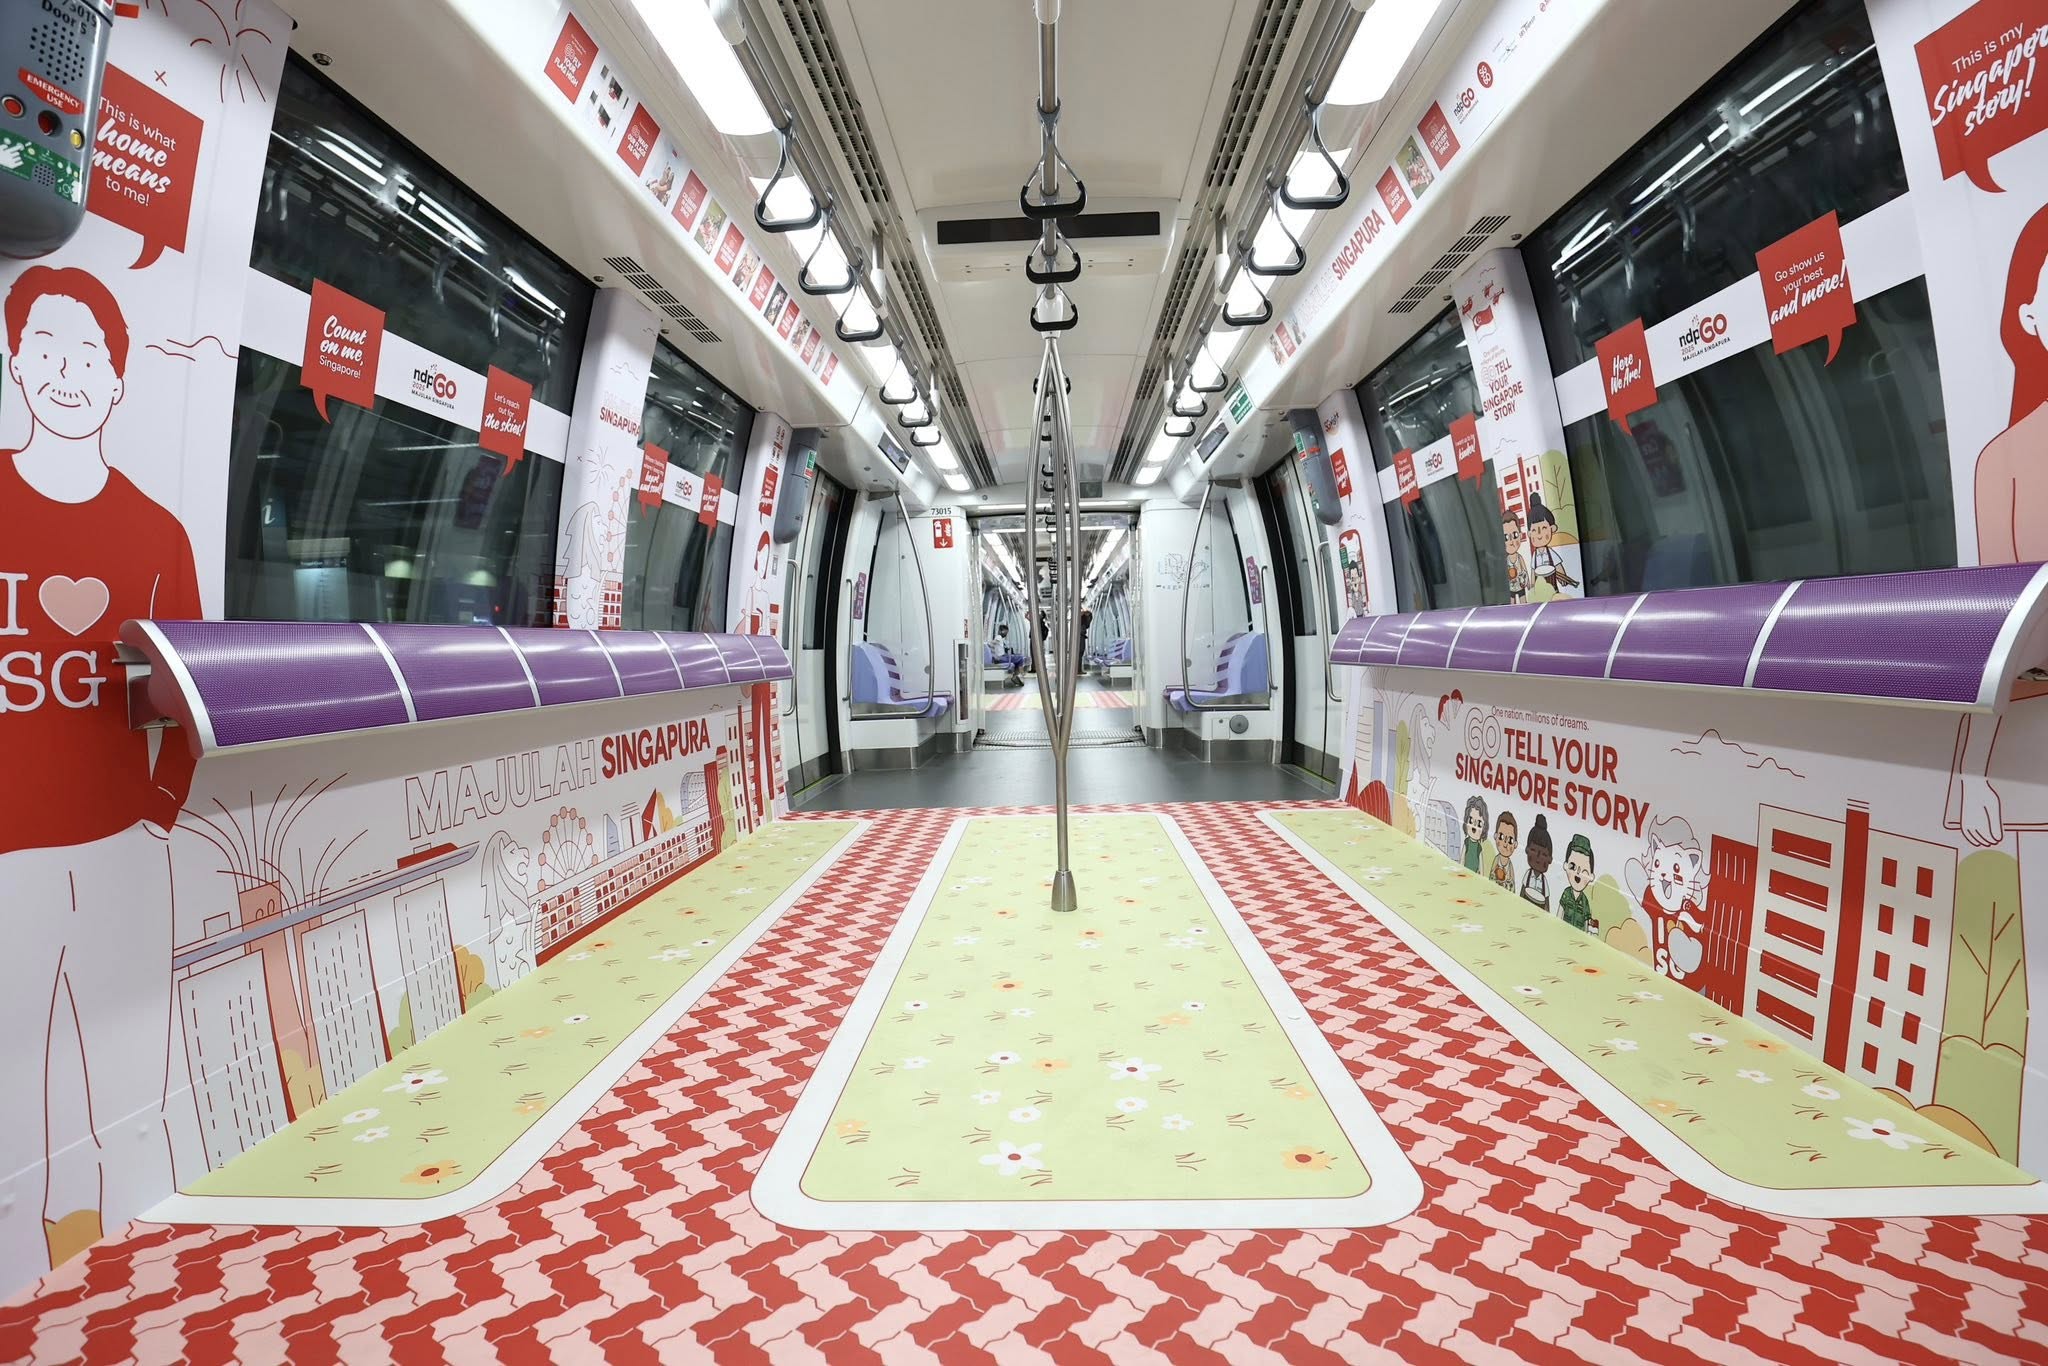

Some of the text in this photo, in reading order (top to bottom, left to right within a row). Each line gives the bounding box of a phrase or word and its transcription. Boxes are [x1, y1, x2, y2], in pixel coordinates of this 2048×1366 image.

[42, 0, 77, 27] Door
[1952, 22, 2023, 73] This is my
[554, 57, 579, 88] FLAG HIGH
[564, 57, 577, 74] YOUR
[1932, 24, 2048, 127] Singapor
[27, 74, 81, 108] EMERGENCY
[46, 93, 64, 109] USE
[1964, 57, 2036, 136] story!
[98, 97, 176, 151] This is what
[1429, 124, 1447, 148] CELEBRATE
[97, 118, 168, 168] home
[1438, 132, 1449, 147] EVERY
[92, 146, 172, 194] means
[105, 176, 120, 193] to
[123, 183, 150, 207] me!
[1332, 208, 1385, 281] SINGAPURA
[1774, 251, 1825, 282] Go show us
[1783, 266, 1824, 295] your best
[1770, 259, 1846, 325] and more!
[323, 315, 368, 345] Count
[319, 339, 364, 366] on me,
[1612, 352, 1633, 372] Here
[1681, 344, 1695, 355] 2025
[1682, 336, 1731, 362] MAJULAH SINGAPURA
[319, 355, 361, 379] Singapore!
[1495, 357, 1512, 375] TELL
[1611, 359, 1641, 395] We Are!
[412, 381, 425, 392] 2025
[1483, 381, 1523, 412] SINGAPORE
[1489, 374, 1509, 393] YOUR
[411, 389, 455, 410] MAJULAH SINGAPURA
[494, 392, 520, 409] Let's reach
[498, 407, 508, 415] out
[1494, 400, 1516, 421] STORY
[484, 413, 526, 437] the skies!
[600, 406, 640, 437] SINGAPURA
[931, 507, 951, 515] 73015
[0, 572, 29, 636] I
[0, 650, 107, 714] SG
[1491, 705, 1589, 731] One nation, millions of dreams.
[1464, 707, 1618, 784] 60 TELL YOUR
[405, 717, 710, 840] MAJULAH SINGAPURA
[1455, 752, 1650, 839] SINGAPORE STORY
